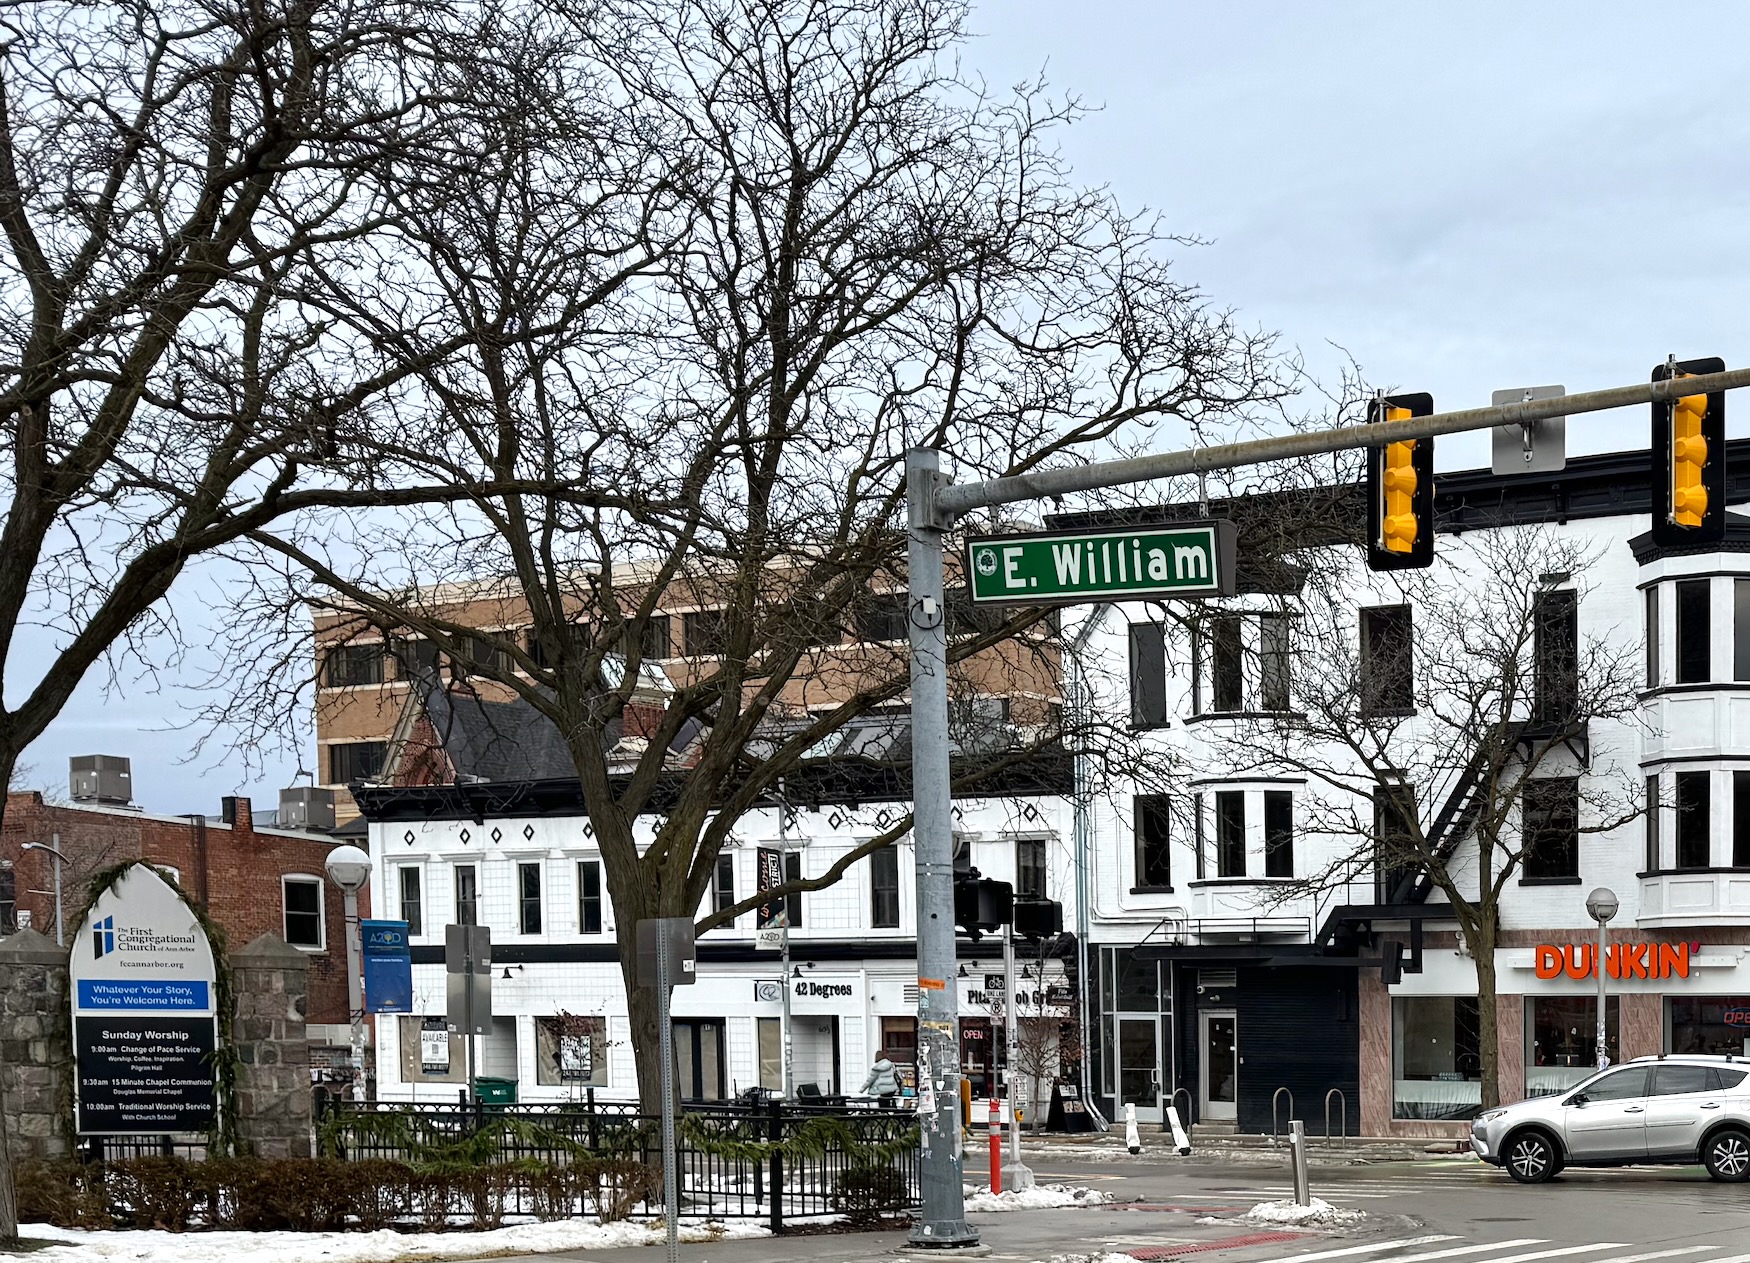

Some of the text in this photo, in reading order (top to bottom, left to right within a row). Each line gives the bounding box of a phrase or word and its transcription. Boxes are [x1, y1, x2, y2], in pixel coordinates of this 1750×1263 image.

[1003, 538, 1209, 589] E. William
[130, 927, 153, 936] First
[117, 933, 196, 944] Congregational
[118, 942, 156, 952] Church
[1535, 940, 1700, 980] DUNKIN'
[92, 985, 139, 994] Whatever
[141, 985, 163, 994] Your
[795, 982, 852, 998] 42 Degrees
[91, 996, 196, 1005] You're Welcome Here.
[102, 1030, 190, 1041] Sunday Worship
[422, 1033, 448, 1043] AVAILABLE
[963, 1030, 983, 1040] OPEN
[120, 1045, 147, 1054] Change
[148, 1045, 156, 1053] of
[156, 1045, 174, 1053] Pace
[175, 1045, 201, 1053] Service
[145, 1079, 170, 1087] Chapel
[118, 1103, 154, 1111] Traditional
[155, 1103, 185, 1111] Worship
[185, 1103, 211, 1111] Service
